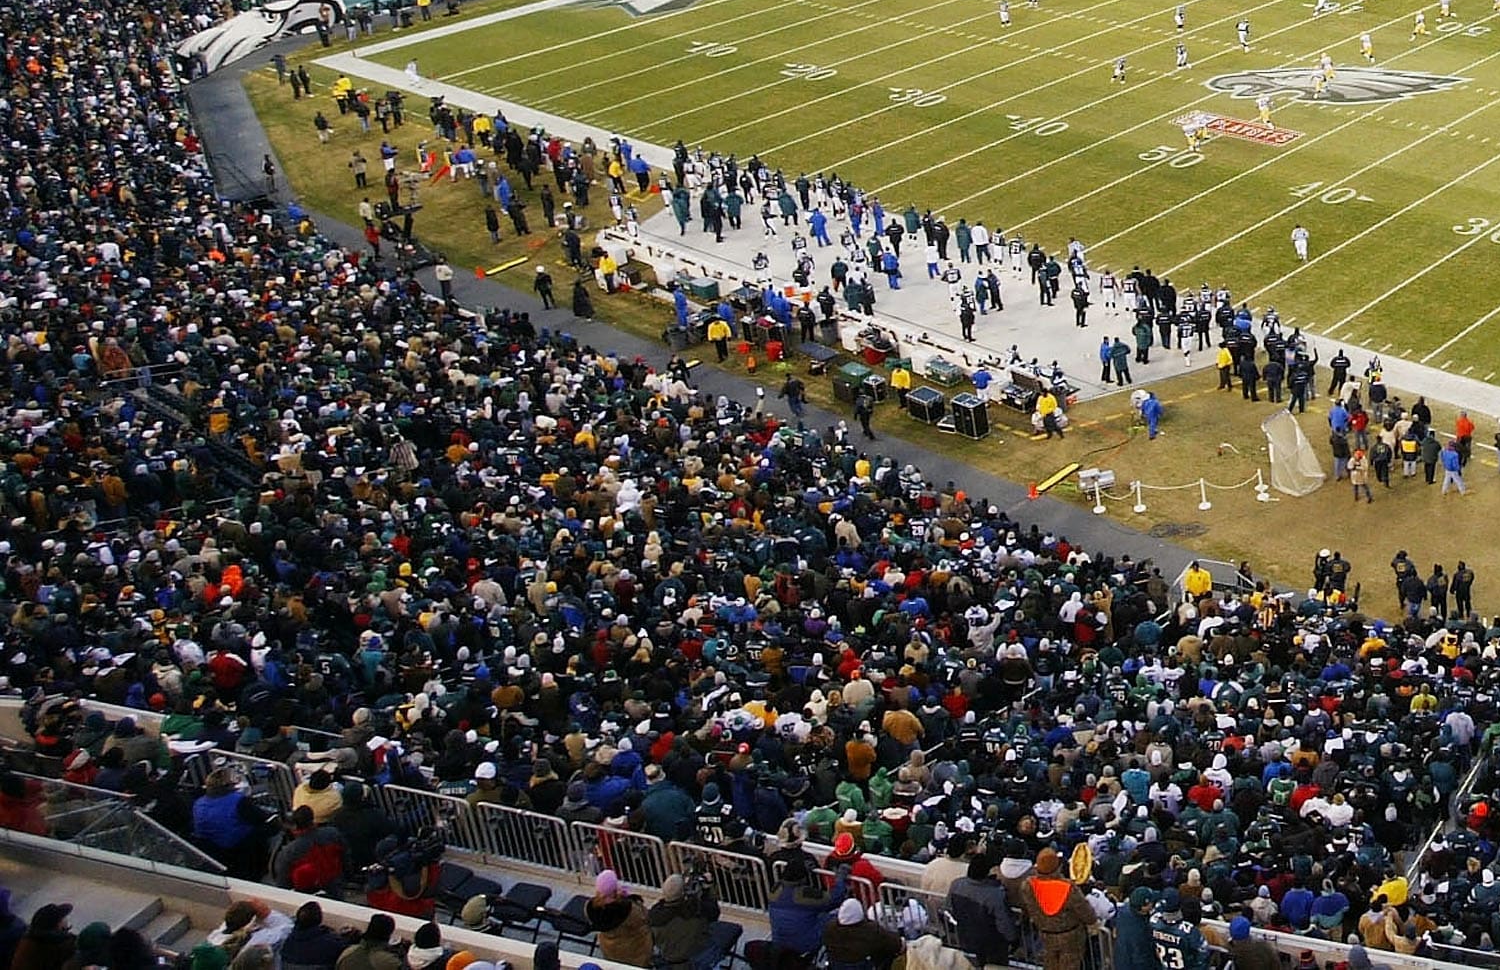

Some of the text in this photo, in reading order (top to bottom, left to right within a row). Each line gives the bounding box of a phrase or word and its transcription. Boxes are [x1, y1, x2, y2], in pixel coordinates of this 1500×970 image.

[685, 41, 738, 57] 10
[779, 63, 838, 80] 20
[889, 88, 948, 107] 30
[1008, 116, 1070, 137] 40
[1138, 145, 1206, 169] 50
[1288, 181, 1357, 204] 40
[322, 661, 330, 675] 5
